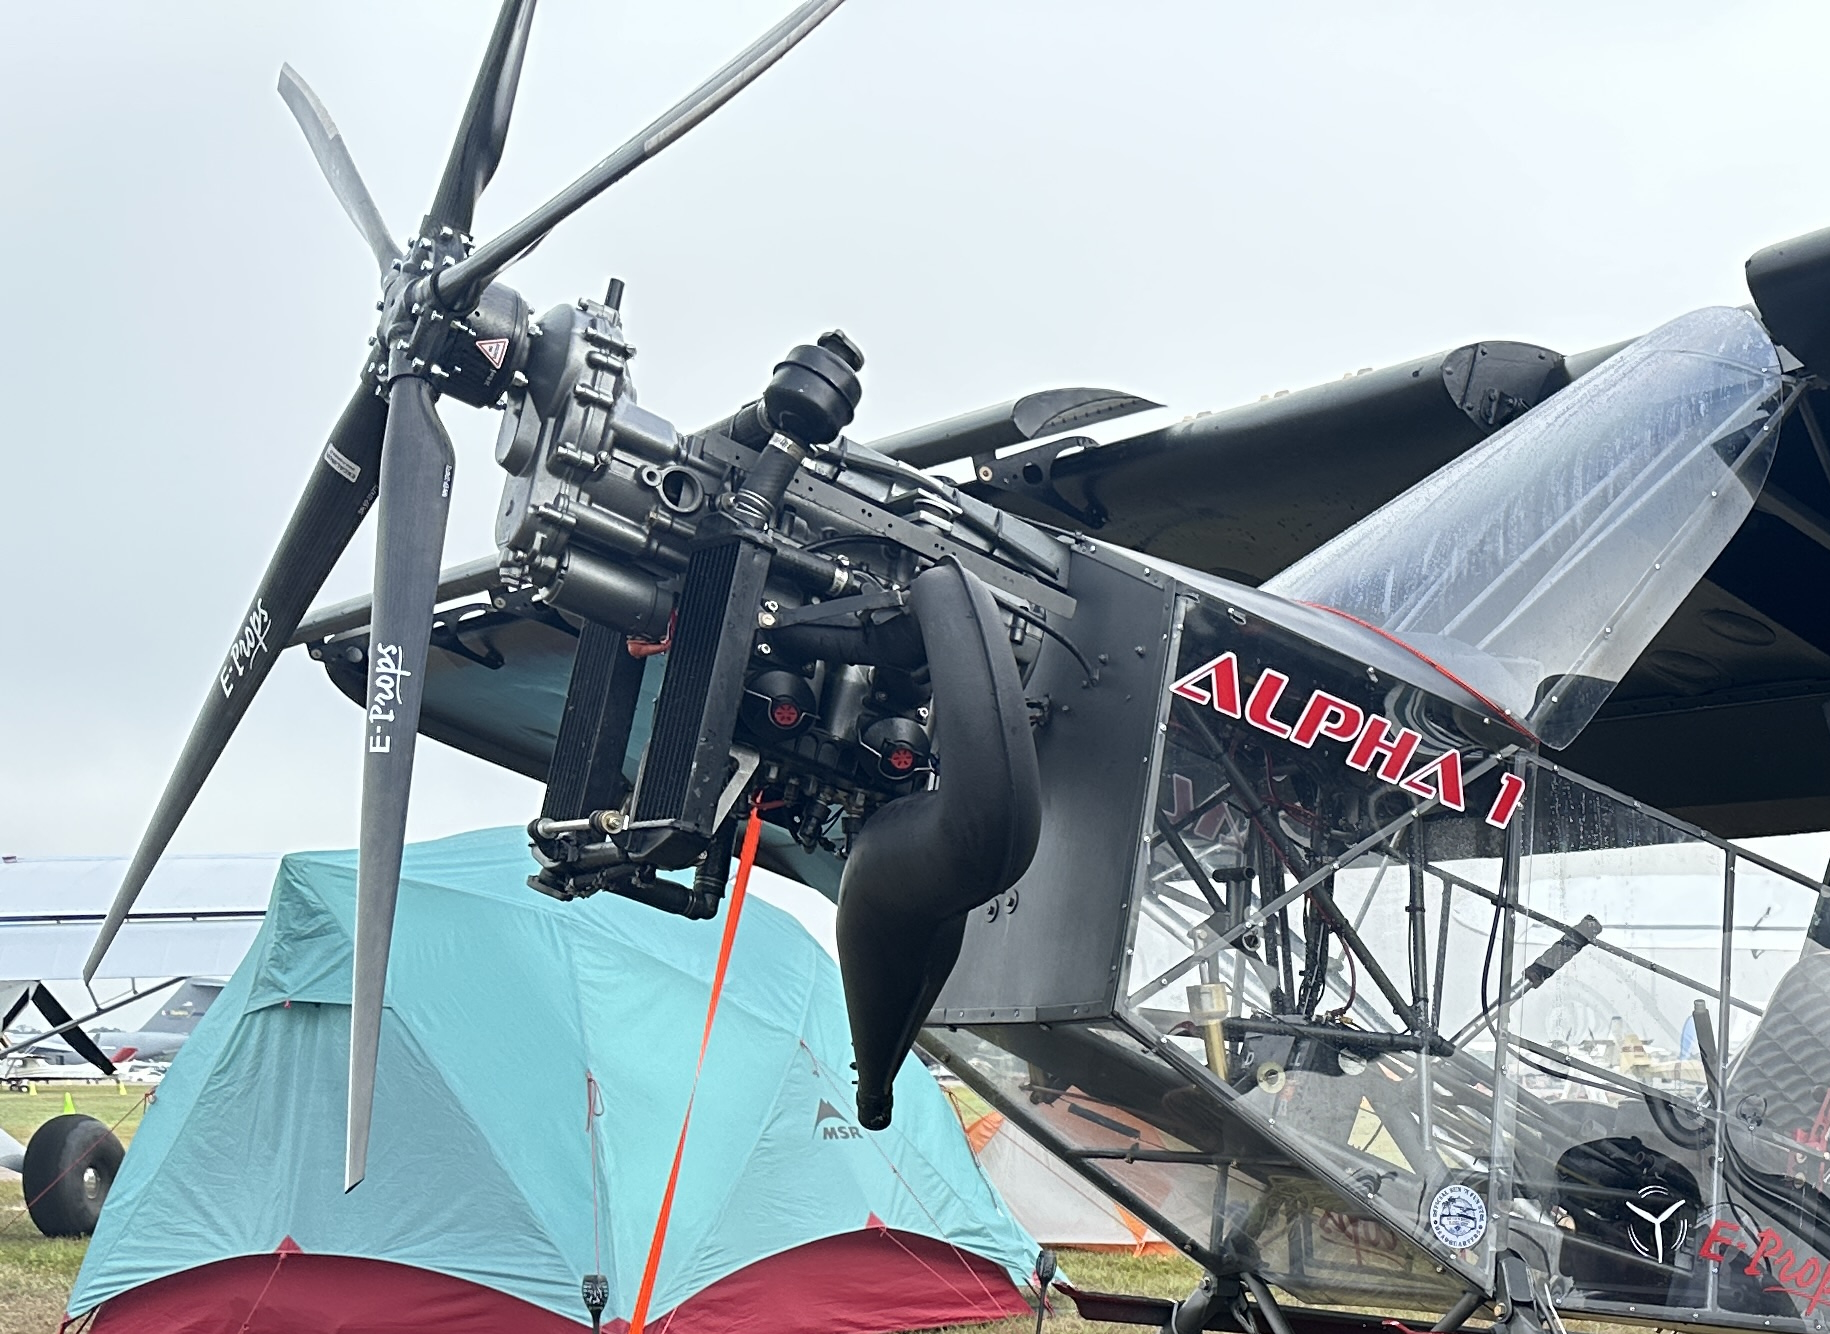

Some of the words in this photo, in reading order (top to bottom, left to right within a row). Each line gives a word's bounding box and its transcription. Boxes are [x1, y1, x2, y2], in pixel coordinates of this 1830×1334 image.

[219, 598, 272, 698] E-Props
[369, 643, 411, 753] E-Props
[1169, 651, 1466, 812] ALPHA
[1485, 772, 1526, 830] 1
[823, 1126, 863, 1140] MSR
